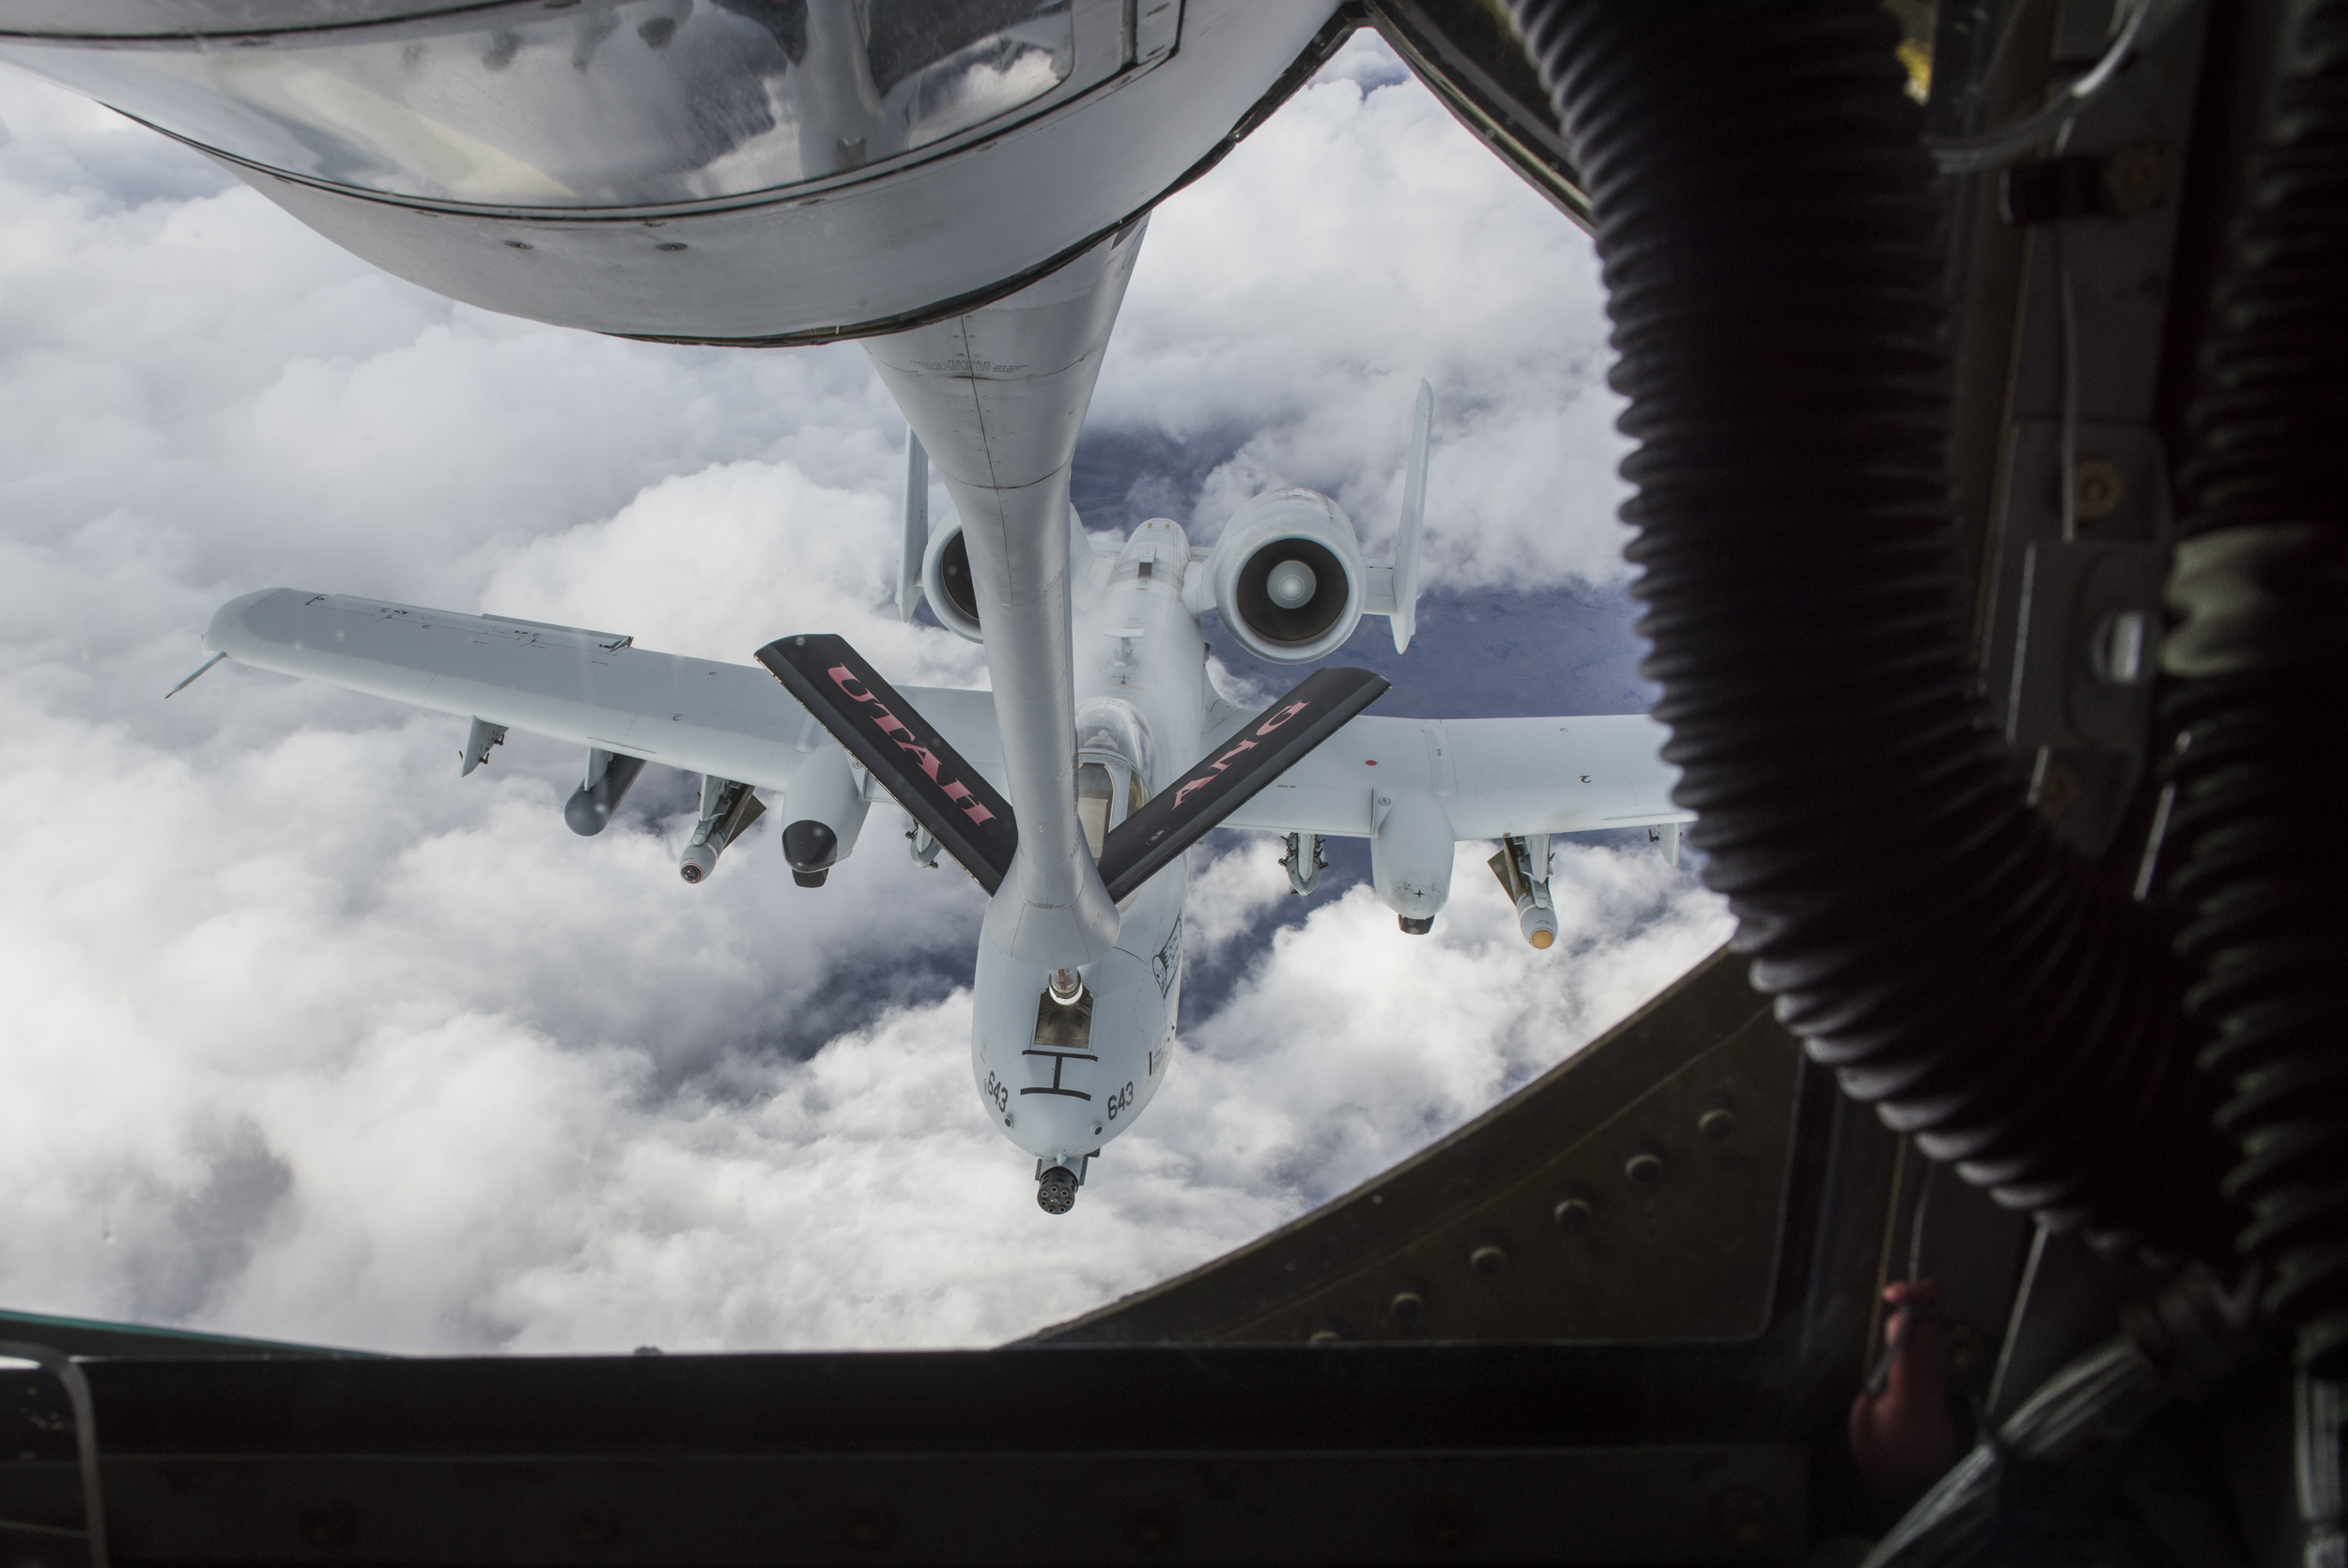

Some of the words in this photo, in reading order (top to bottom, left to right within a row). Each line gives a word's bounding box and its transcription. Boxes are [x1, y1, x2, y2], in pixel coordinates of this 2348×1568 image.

[828, 663, 996, 827] UTAH
[1171, 699, 1311, 810] ANG
[988, 1070, 1008, 1113] 643
[1107, 1081, 1134, 1120] 643
